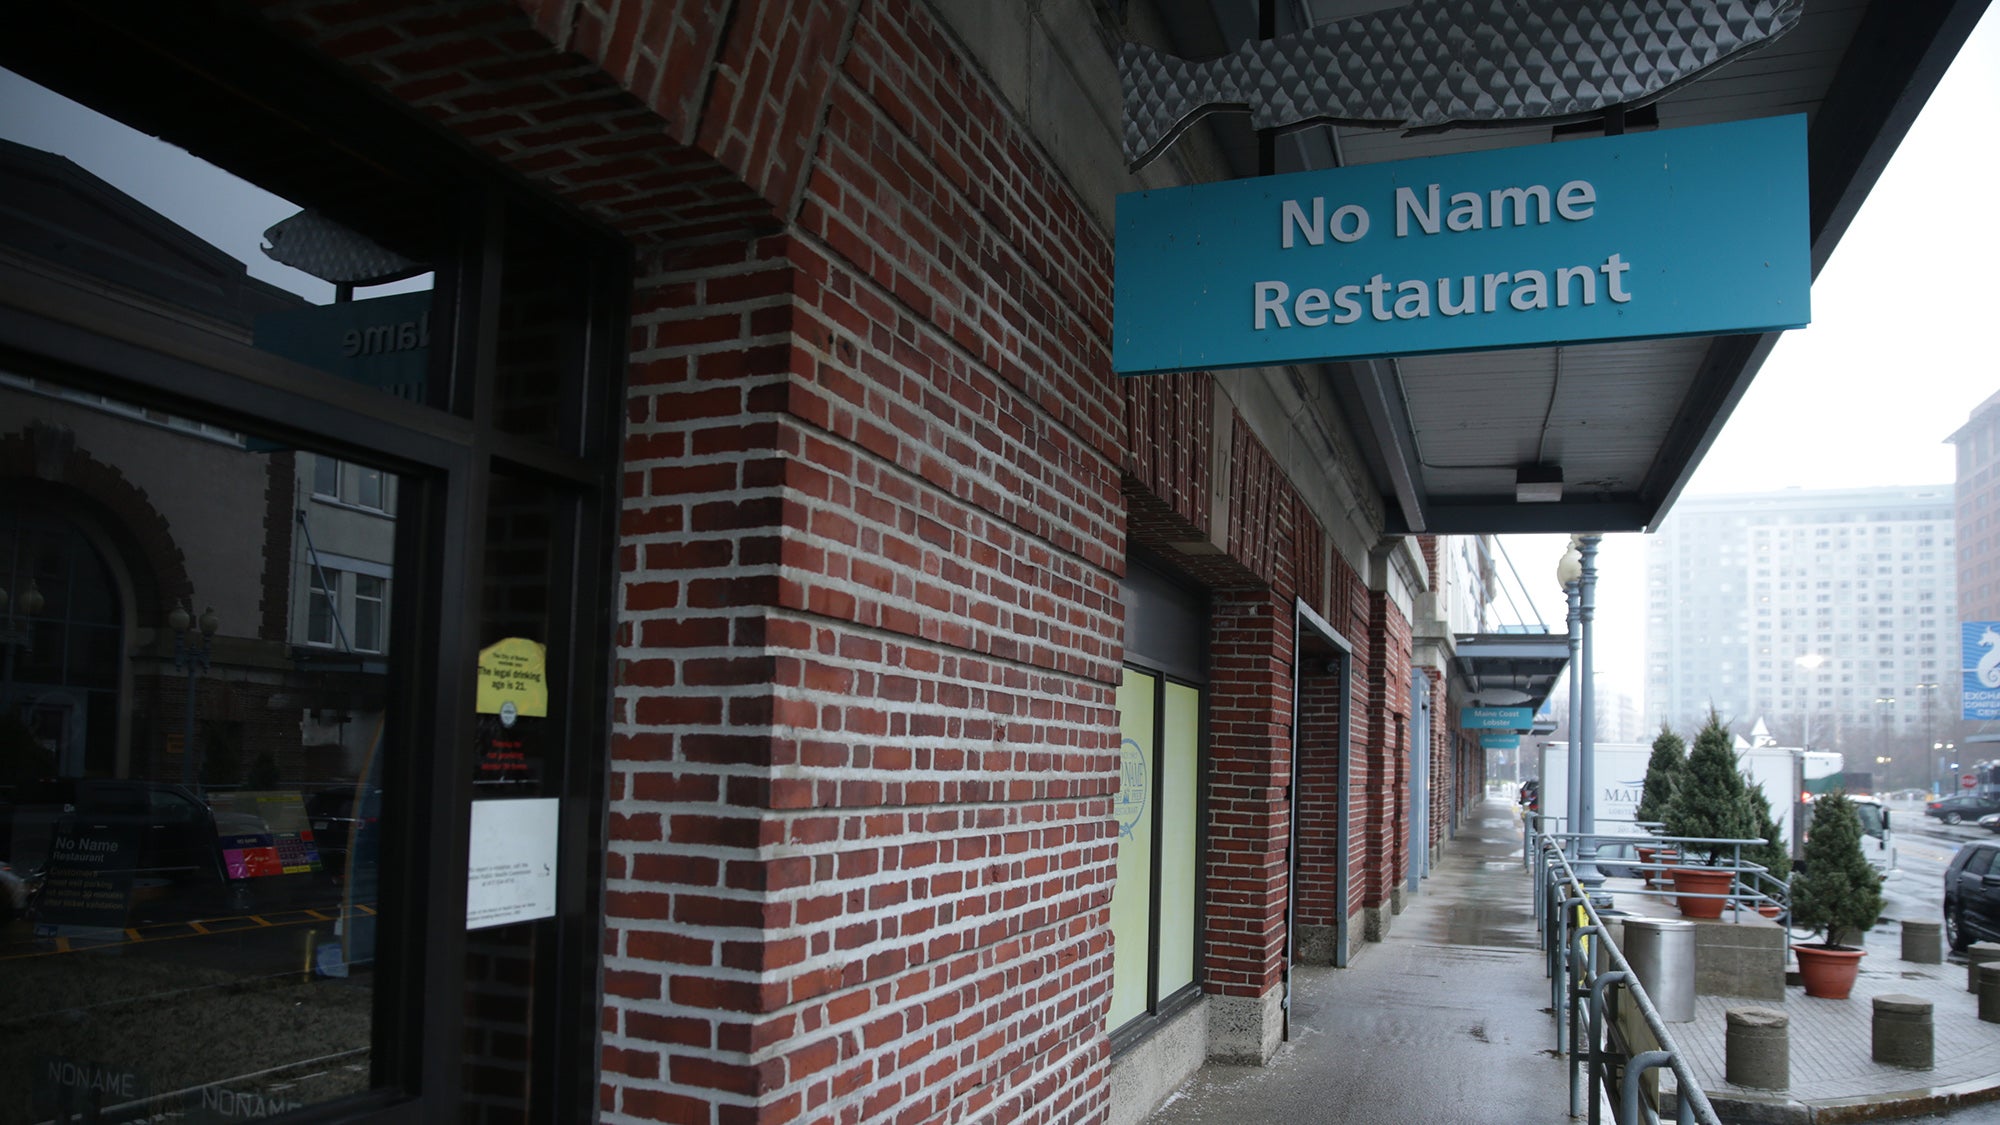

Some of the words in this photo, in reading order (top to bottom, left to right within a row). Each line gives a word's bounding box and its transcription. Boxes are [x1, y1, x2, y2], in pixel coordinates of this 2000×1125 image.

[1281, 196, 1370, 249] No
[1396, 178, 1598, 238] Name
[1253, 252, 1632, 331] Restaurant
[494, 668, 511, 679] legal
[513, 670, 541, 683] drinking
[492, 681, 505, 690] age
[507, 681, 513, 689] is
[1603, 788, 1640, 802] MAI
[55, 836, 74, 849] No
[78, 837, 119, 853] Name
[53, 851, 105, 863] Restaurant
[202, 1086, 303, 1119] NONAM
